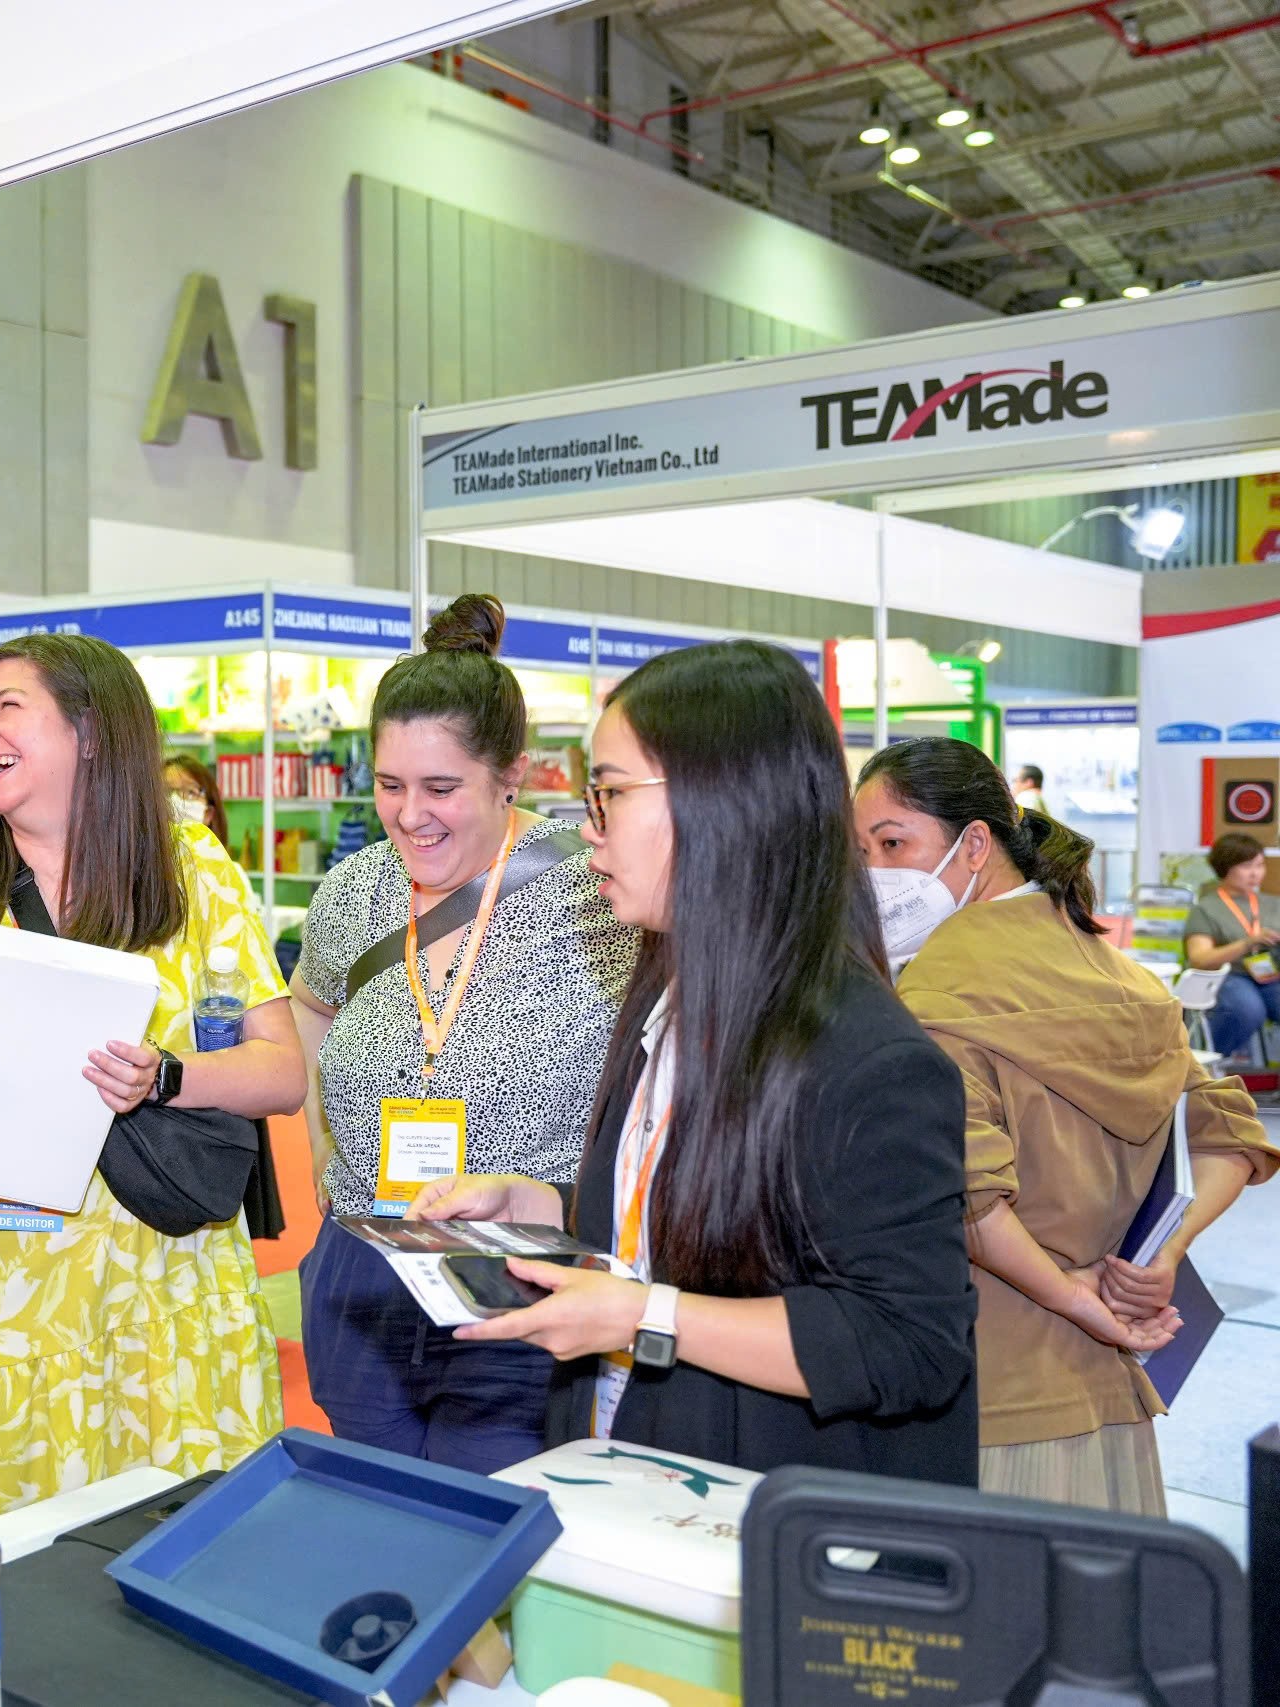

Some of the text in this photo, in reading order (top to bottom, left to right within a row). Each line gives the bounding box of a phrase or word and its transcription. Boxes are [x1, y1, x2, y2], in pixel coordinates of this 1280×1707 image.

[140, 272, 317, 471] A1
[801, 360, 1108, 450] TEAMade
[453, 433, 643, 473] TEAMade International Inc.
[453, 445, 719, 496] TEAMade Stationery Vietnam Co., Ltd
[224, 608, 261, 628] A145
[14, 1217, 55, 1229] VISITOR
[381, 1204, 408, 1214] TRAD
[842, 1636, 918, 1671] BLACK
